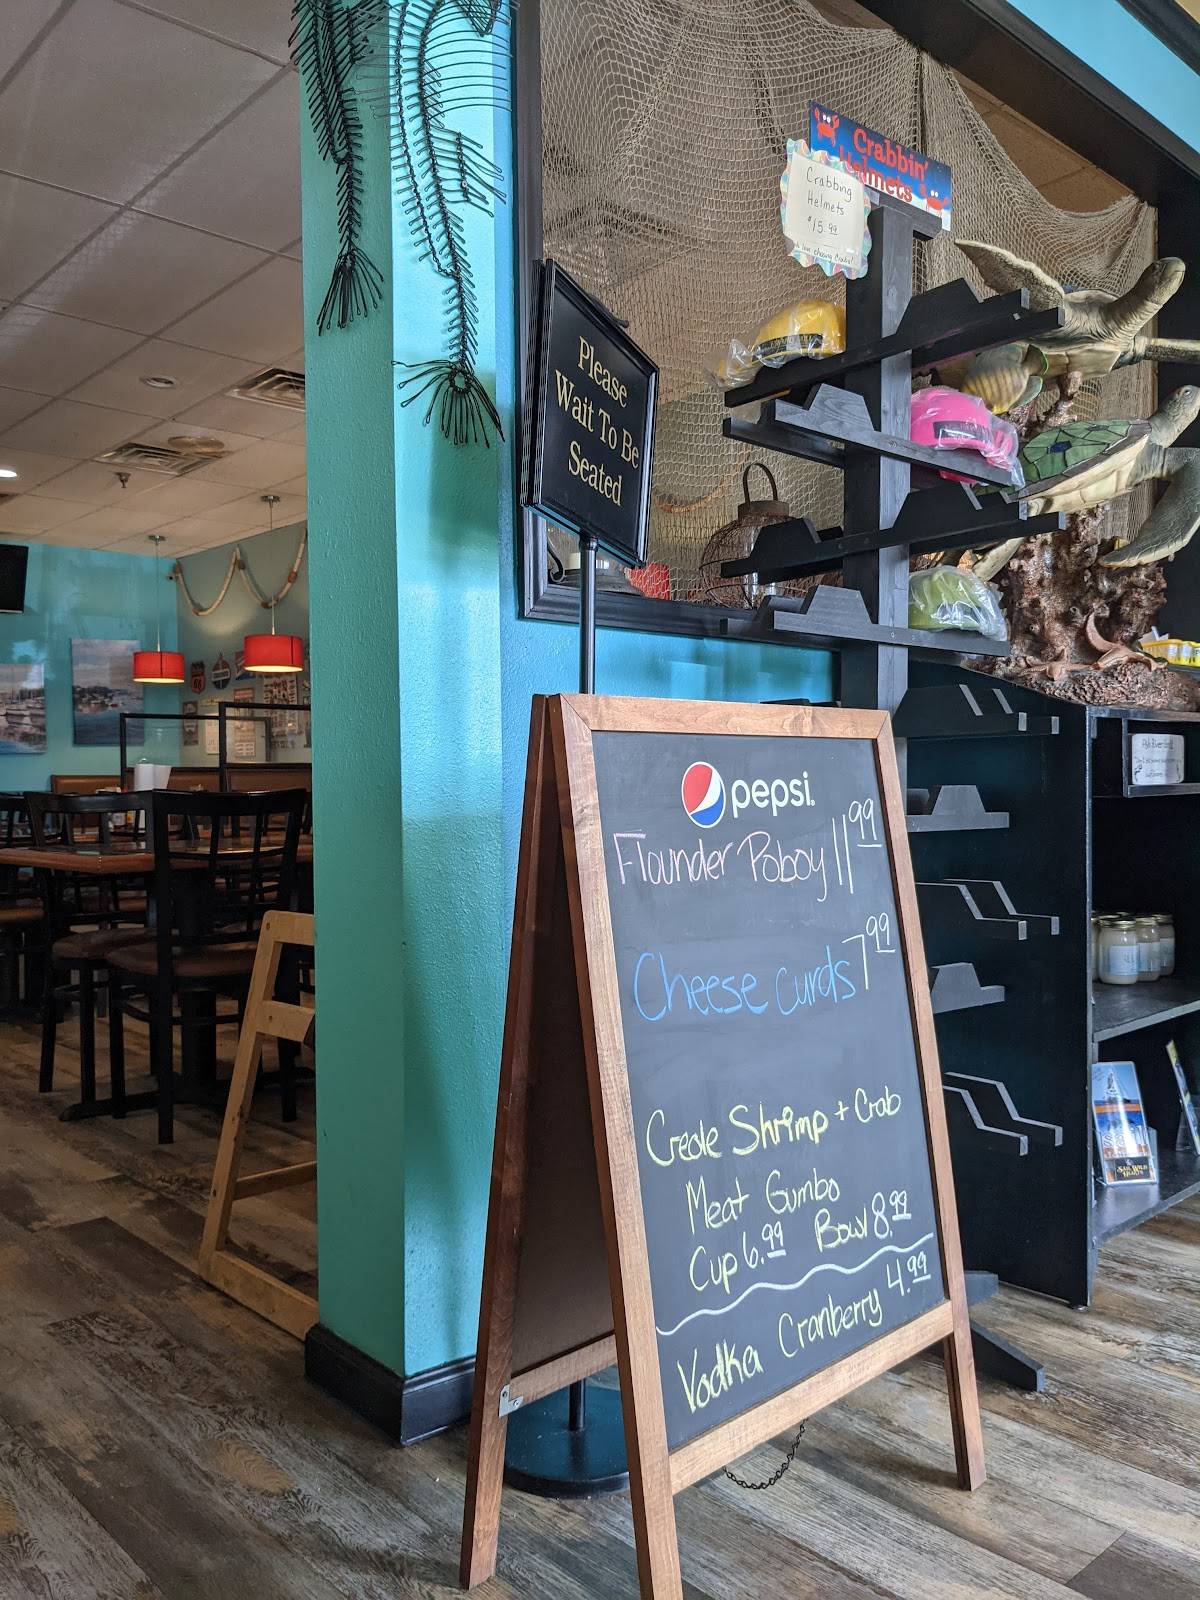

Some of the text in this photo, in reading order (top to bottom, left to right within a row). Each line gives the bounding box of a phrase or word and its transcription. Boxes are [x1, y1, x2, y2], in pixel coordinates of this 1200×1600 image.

[806, 166, 852, 201] Crabbing
[853, 128, 928, 181] Crabbin'
[807, 191, 844, 215] Helmets
[577, 335, 628, 408] Please
[555, 369, 639, 469] Wait To Be
[568, 440, 622, 506] Seated
[731, 770, 812, 818] pepsi
[613, 829, 734, 885] Flounder
[737, 831, 828, 902] Poboy
[634, 952, 769, 1021] Cheese
[646, 1086, 901, 1167] Creole Shrimp + Crab
[686, 1168, 841, 1235] Meat Gumbo
[689, 1246, 738, 1294] Cup
[814, 1203, 868, 1253] Bowl
[677, 1339, 764, 1414] Vodka
[778, 1288, 883, 1358] Cranberry
